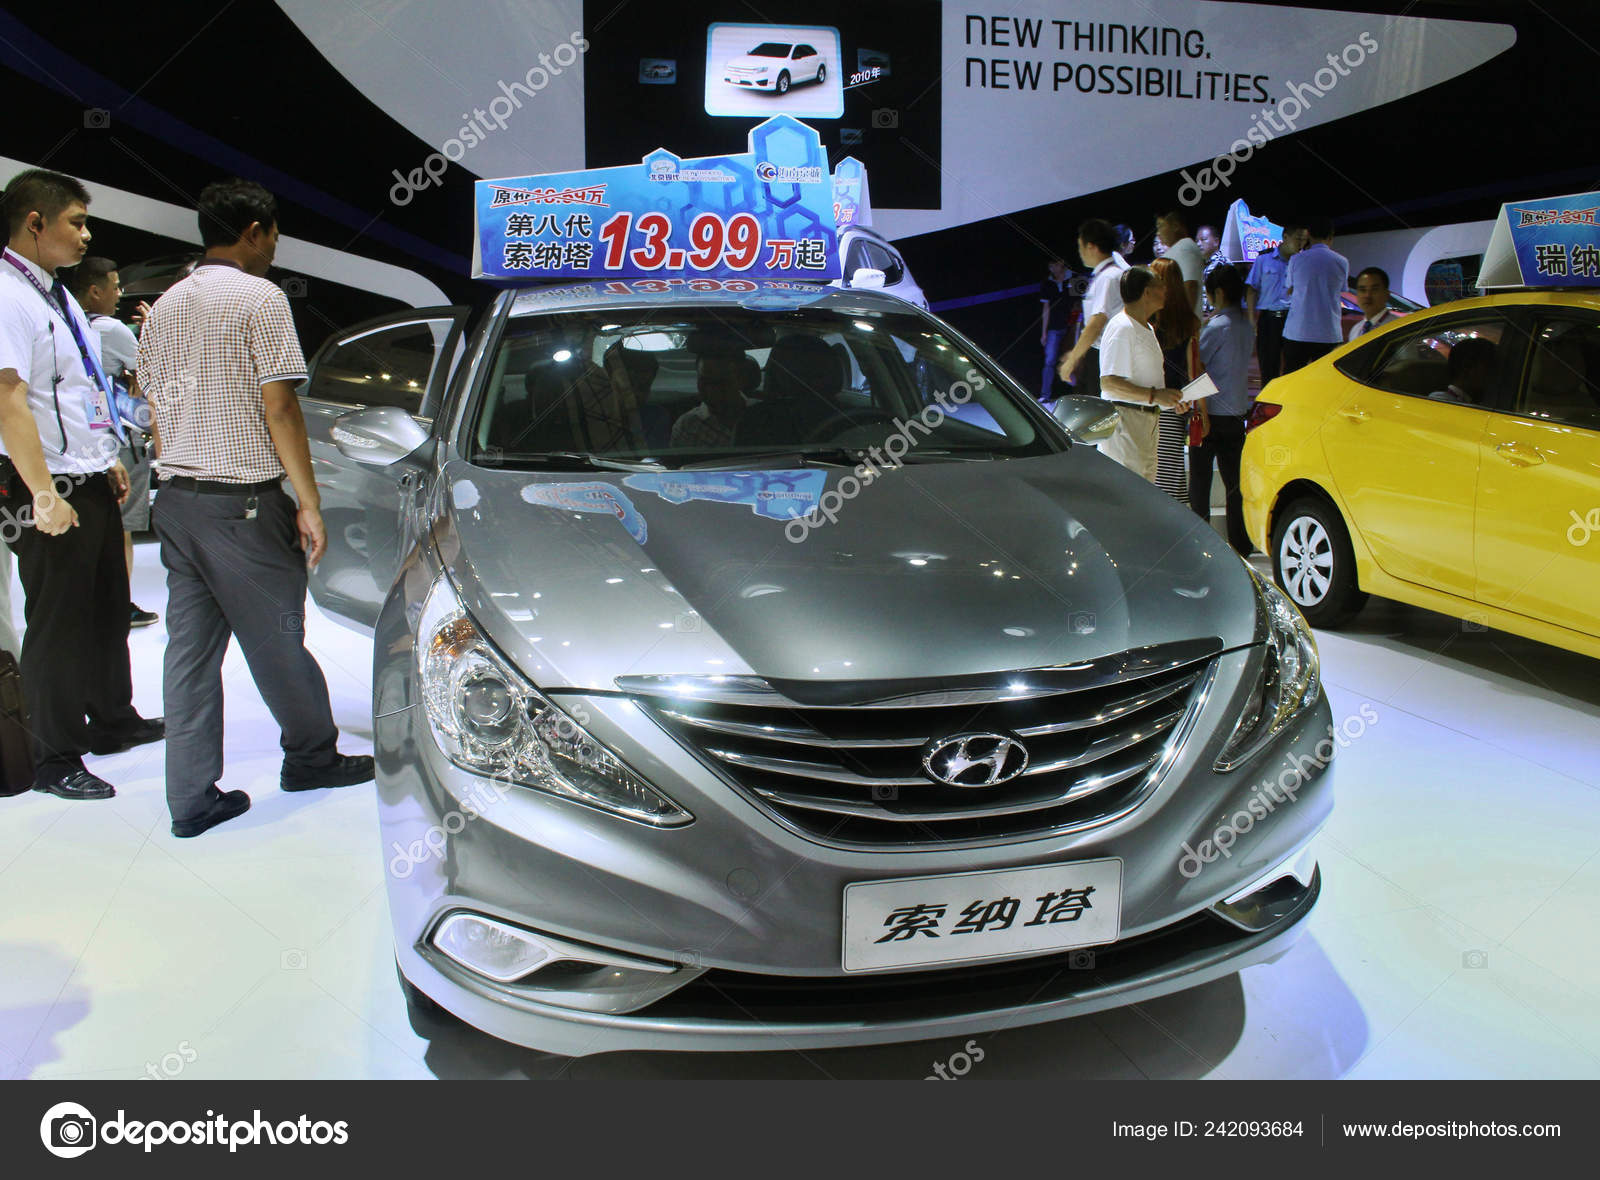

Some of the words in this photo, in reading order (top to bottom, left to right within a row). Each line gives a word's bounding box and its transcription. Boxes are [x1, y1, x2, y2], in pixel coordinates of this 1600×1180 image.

[965, 15, 1043, 49] NEW
[1051, 20, 1211, 59] THINKING.
[965, 57, 1043, 91] NEW
[1053, 62, 1276, 105] POSSIBILITIES.
[505, 212, 593, 238] 第八代
[503, 240, 593, 270] 索纳塔
[1535, 244, 1600, 277] 瑞纳
[873, 885, 1097, 944] 索纳塔
